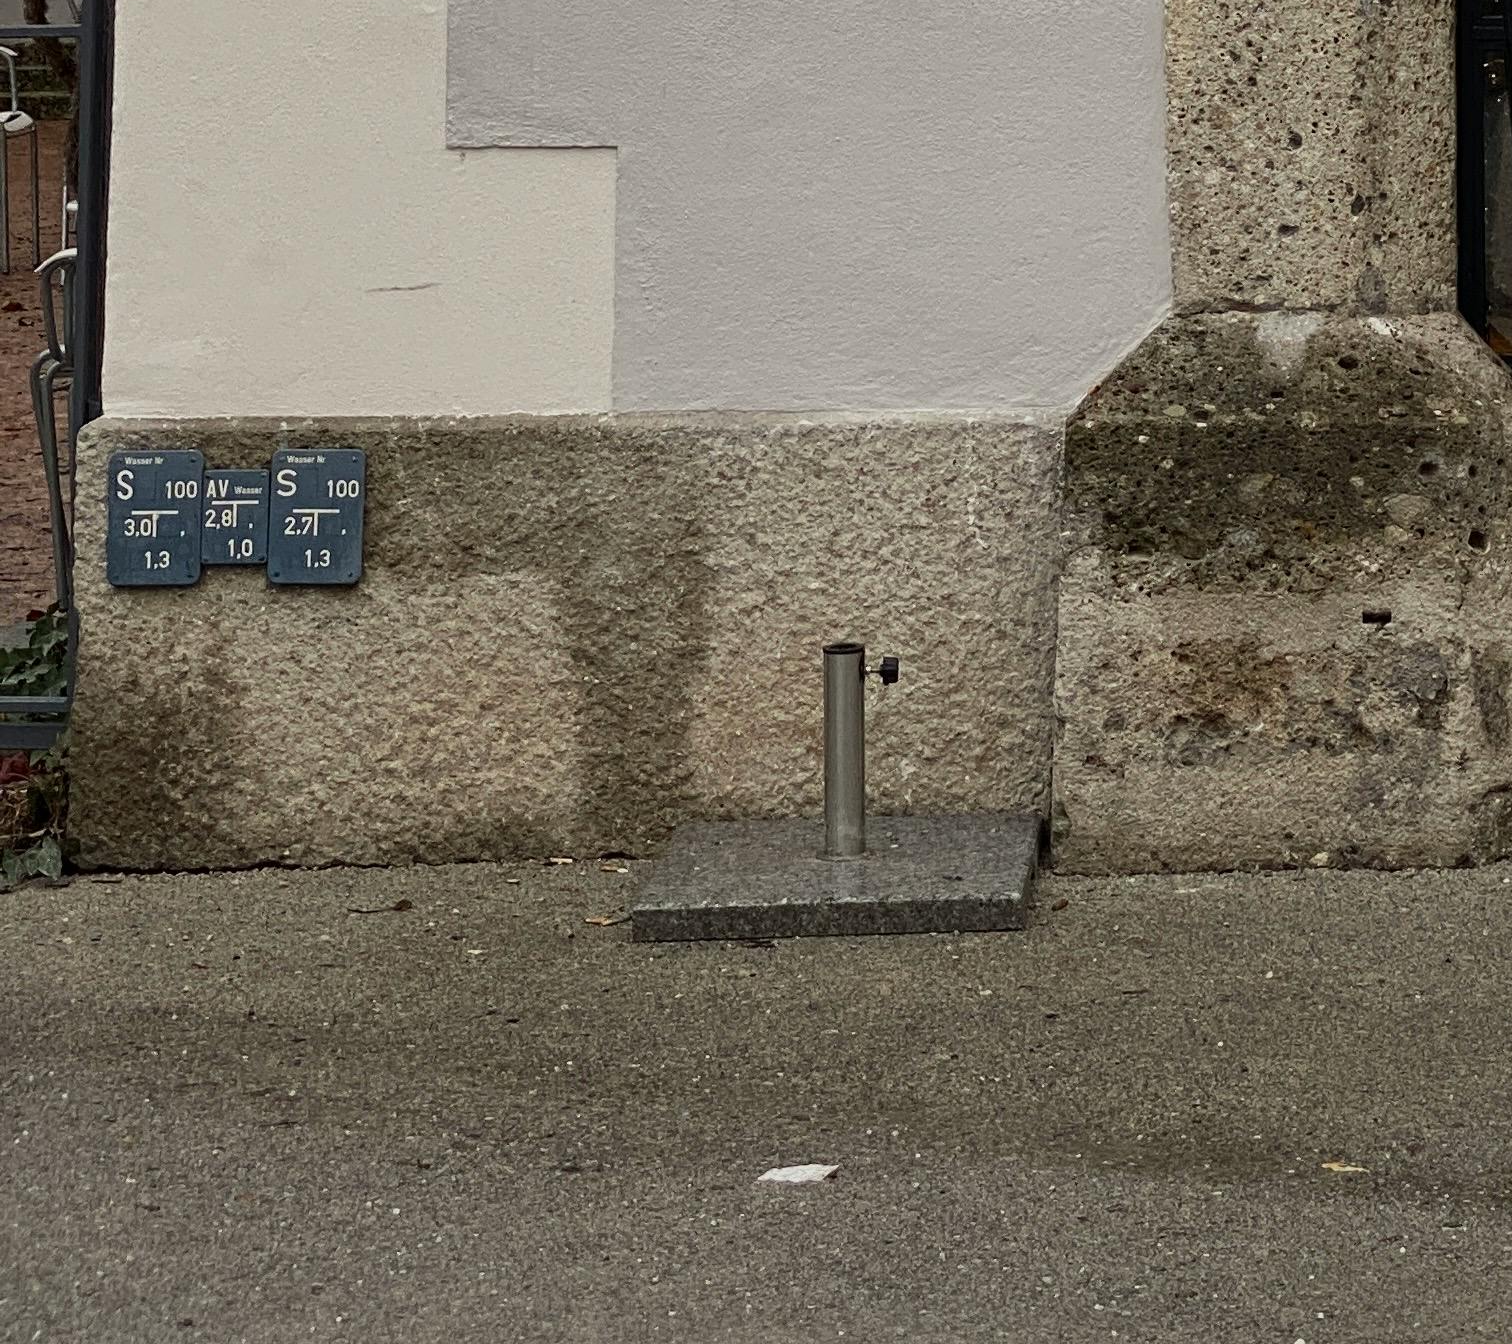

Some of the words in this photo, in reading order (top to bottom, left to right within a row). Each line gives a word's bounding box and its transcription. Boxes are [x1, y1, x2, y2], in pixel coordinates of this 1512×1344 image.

[116, 469, 134, 501] S
[165, 480, 198, 500] 100
[206, 479, 230, 499] AV
[234, 485, 263, 495] Wasser
[276, 469, 297, 498] S
[326, 479, 360, 499] 100
[123, 518, 152, 538] 3,0
[204, 509, 232, 529] 2,8
[283, 516, 313, 536] 2,7
[227, 538, 254, 560] 1,0
[304, 549, 331, 568] 1,3
[144, 550, 171, 570] 1,3
